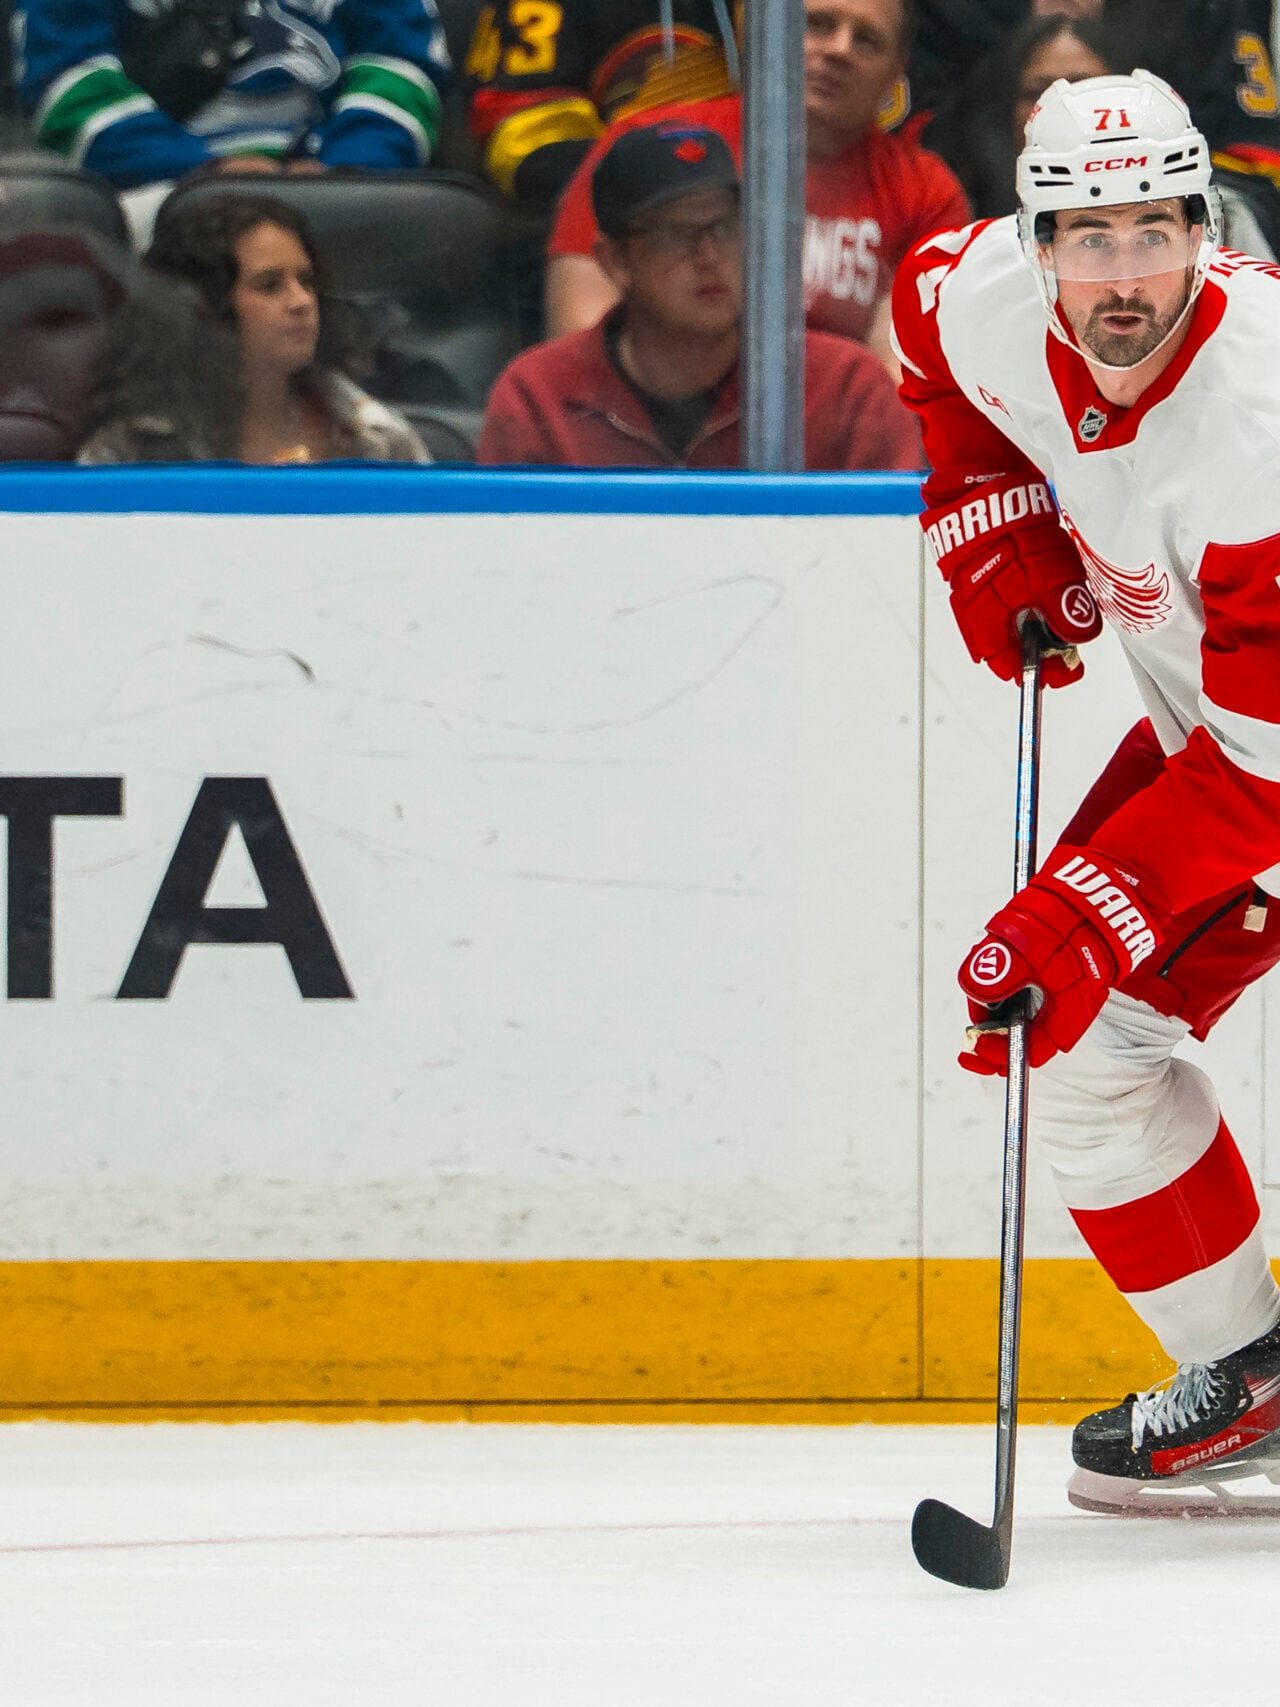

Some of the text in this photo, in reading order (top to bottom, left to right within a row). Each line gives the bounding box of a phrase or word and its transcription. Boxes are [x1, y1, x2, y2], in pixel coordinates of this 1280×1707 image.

[1093, 108, 1131, 131] 71
[1084, 156, 1148, 173] CCM
[927, 483, 1053, 560] ARRIOR
[970, 553, 1001, 584] COVERT
[0, 776, 357, 1000] TA
[1081, 946, 1101, 980] COVERT
